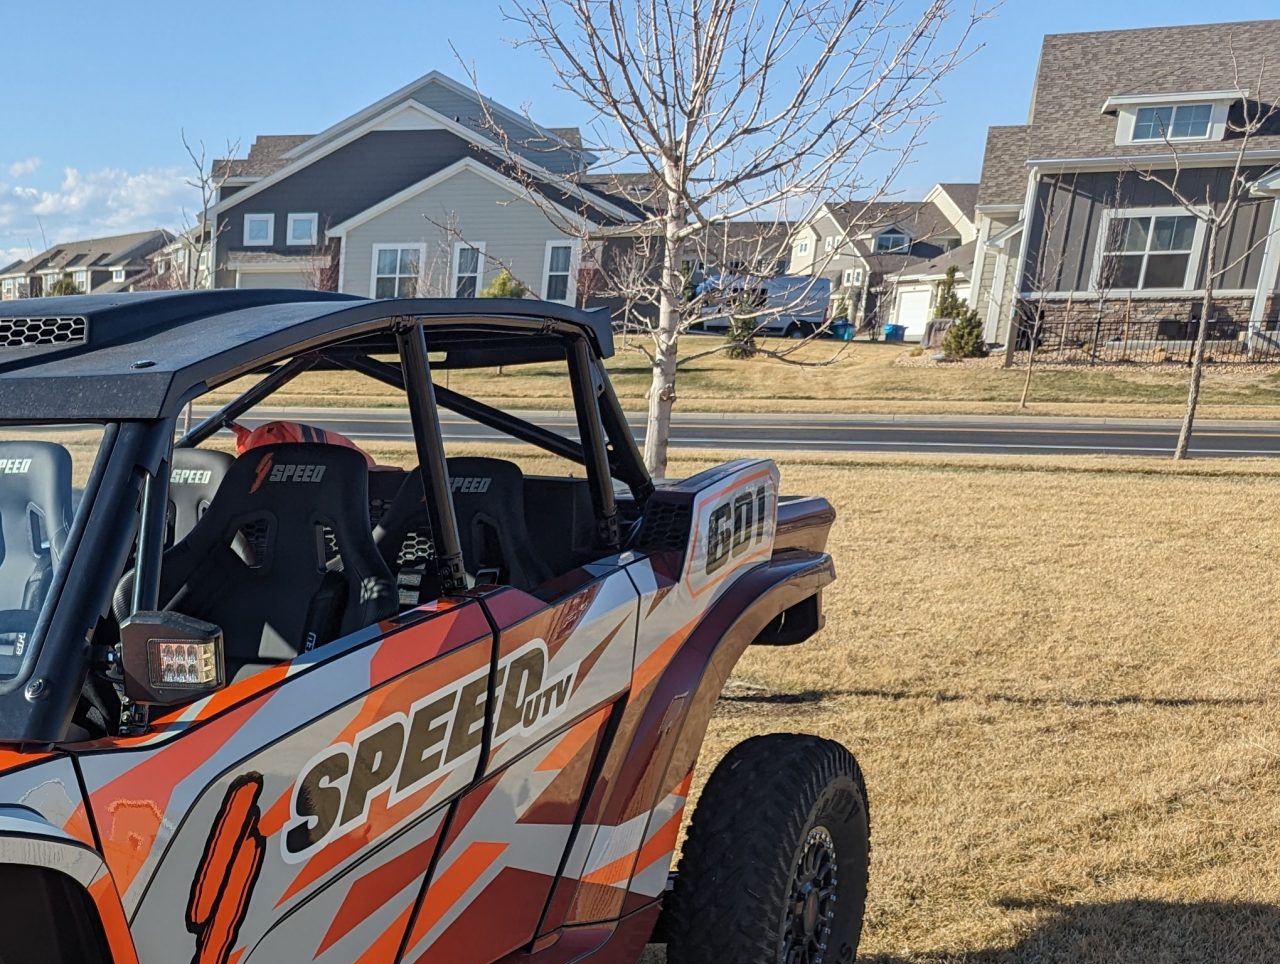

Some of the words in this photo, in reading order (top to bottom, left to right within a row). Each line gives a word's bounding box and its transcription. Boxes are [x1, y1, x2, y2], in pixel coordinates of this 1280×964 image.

[170, 468, 212, 484] SPEED
[269, 464, 326, 483] SPEED
[285, 645, 547, 857] SPEED
[523, 672, 573, 729] UTV
